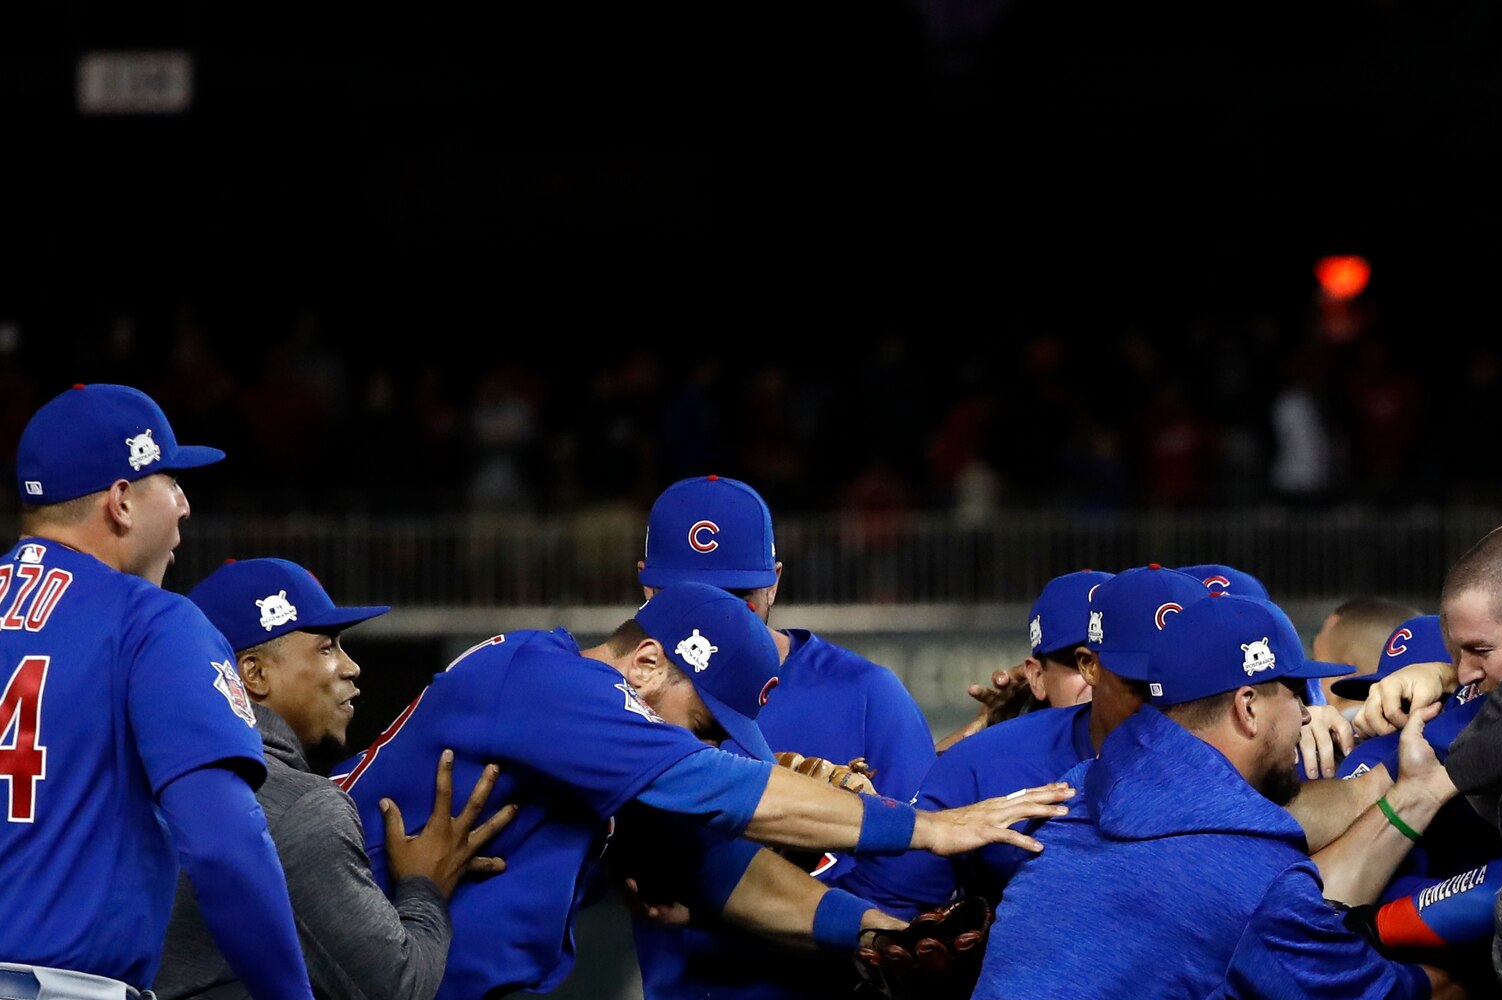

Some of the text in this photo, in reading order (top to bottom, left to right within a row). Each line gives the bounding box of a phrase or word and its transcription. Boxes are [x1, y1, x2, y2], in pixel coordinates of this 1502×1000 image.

[688, 520, 720, 554] C
[1387, 628, 1413, 657] C
[1418, 864, 1488, 912] VENEZUELA
